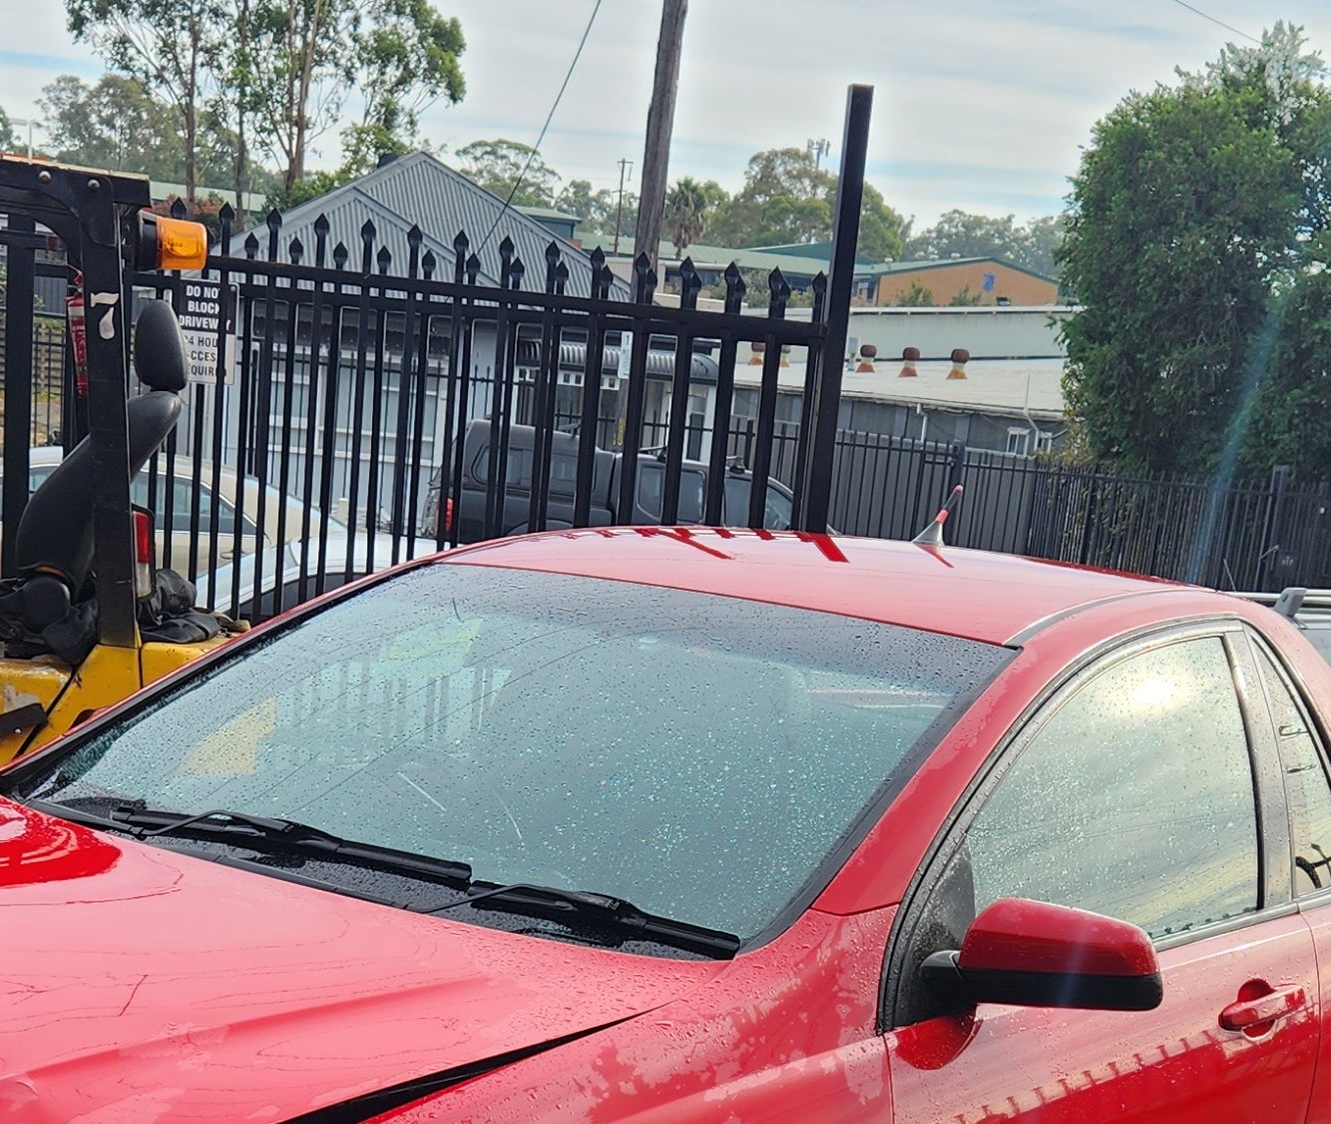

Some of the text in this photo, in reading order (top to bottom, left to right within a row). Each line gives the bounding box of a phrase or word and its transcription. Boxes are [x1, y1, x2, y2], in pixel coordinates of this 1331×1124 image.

[186, 285, 220, 299] DO NO
[90, 292, 119, 340] 7
[179, 315, 231, 331] DRIVEWY
[198, 336, 218, 348] HOU
[188, 351, 216, 362] CCES
[190, 364, 215, 376] QUIR
